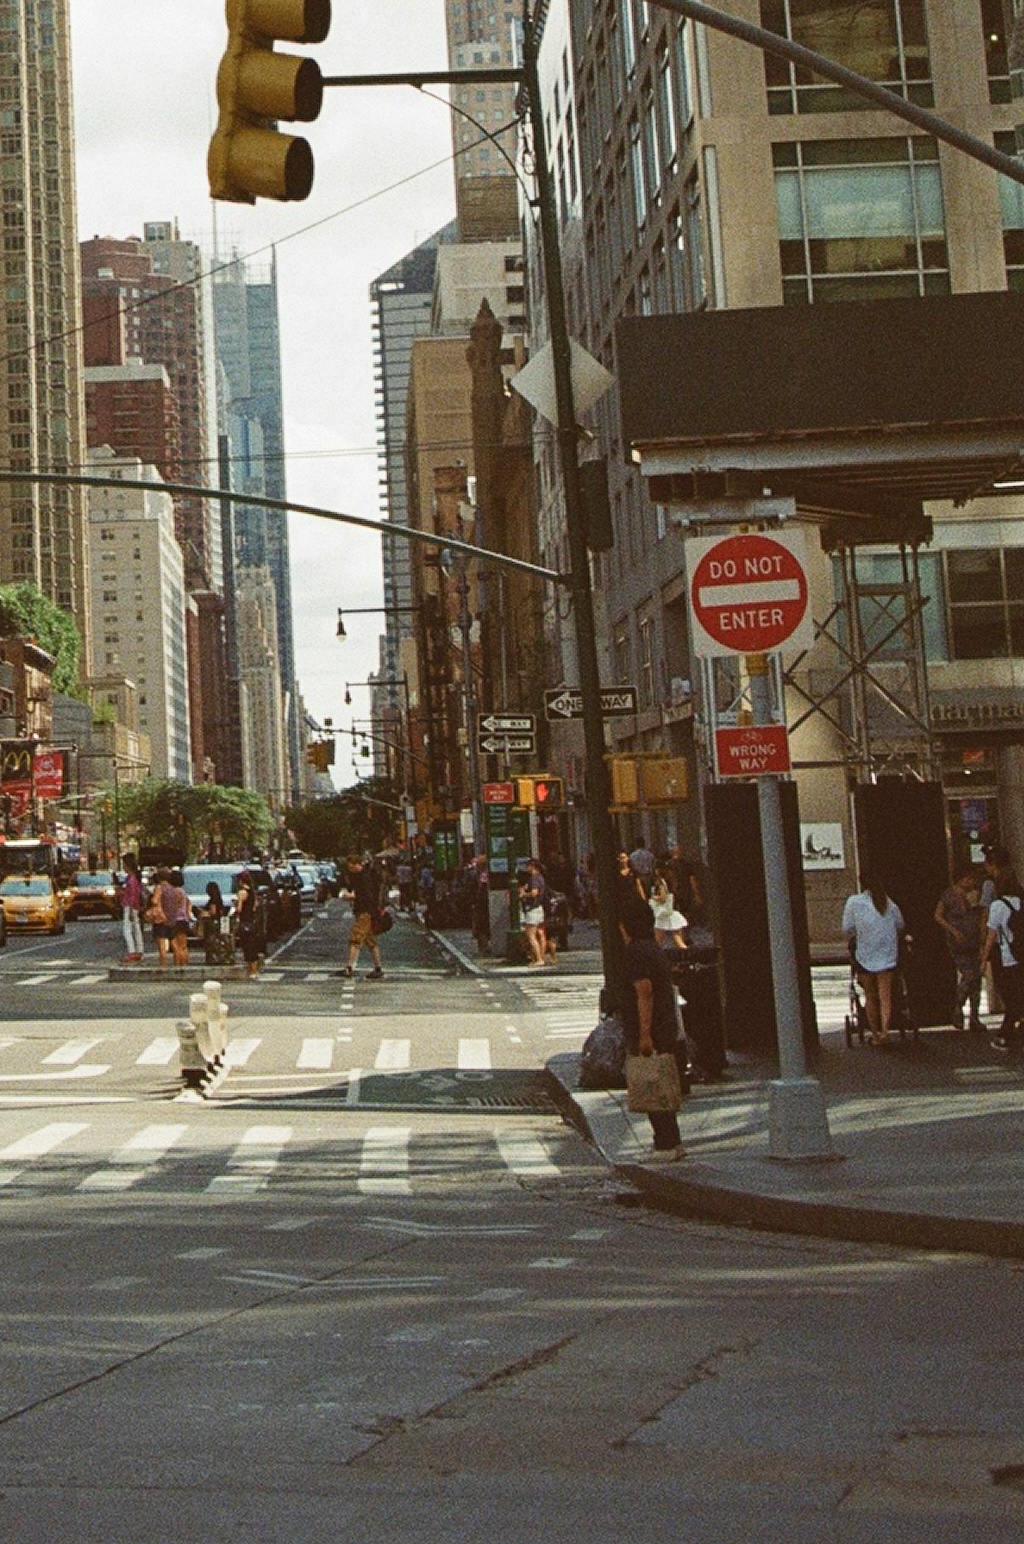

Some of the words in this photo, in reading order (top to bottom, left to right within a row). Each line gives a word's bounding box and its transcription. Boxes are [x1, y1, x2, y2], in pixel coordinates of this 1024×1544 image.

[709, 559, 737, 579] DO
[744, 555, 783, 576] NOT
[719, 608, 785, 631] ENTER
[556, 698, 583, 711] ONE
[601, 695, 629, 709] WAY
[728, 743, 777, 757] WRONG
[738, 757, 769, 770] WAY
